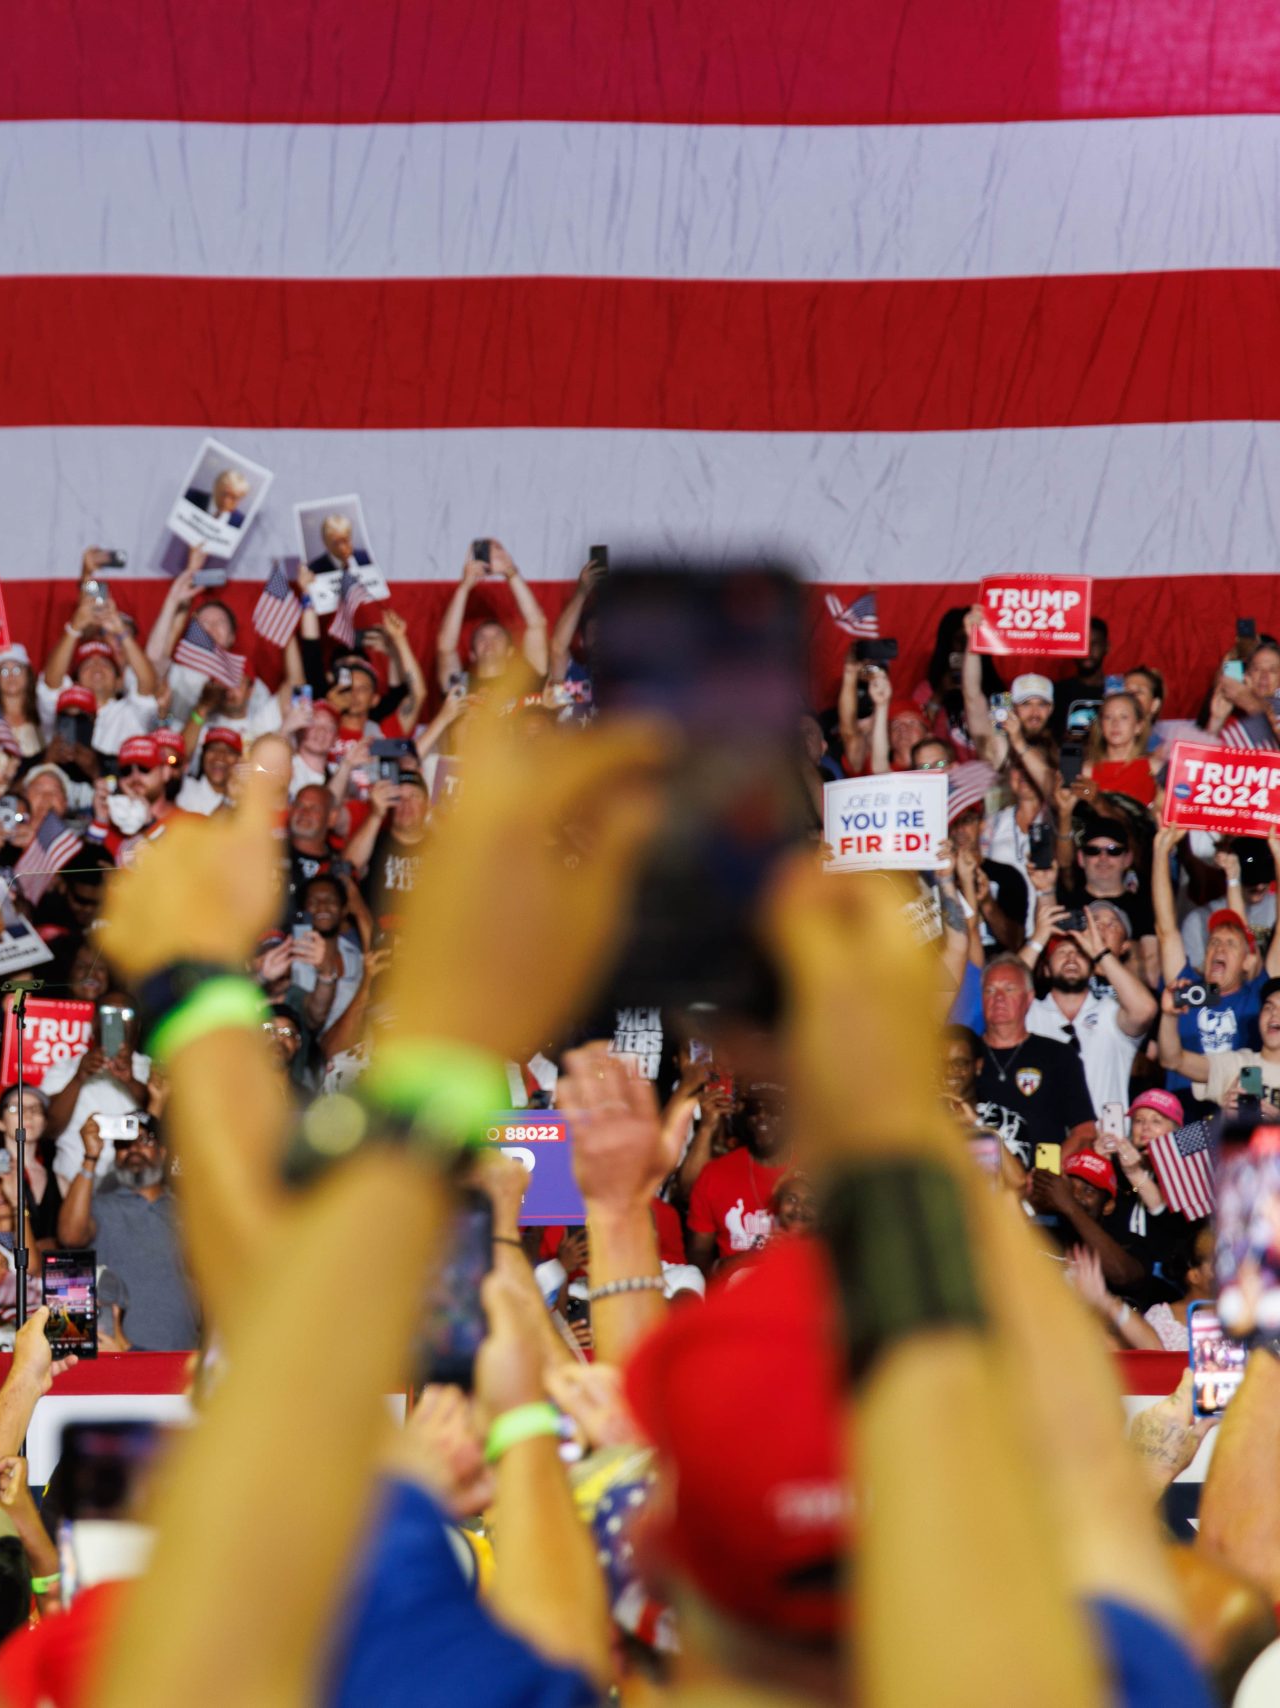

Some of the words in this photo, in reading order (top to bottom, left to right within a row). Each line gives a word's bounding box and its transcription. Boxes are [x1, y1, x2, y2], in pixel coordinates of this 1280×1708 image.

[987, 588, 1081, 611] TRUMP
[997, 607, 1066, 630] 2024
[1183, 759, 1280, 790] TRUMP
[874, 790, 922, 808] BIEN
[1193, 783, 1270, 810] 2024
[841, 810, 925, 832] YOURE
[23, 1016, 93, 1044] TRU
[31, 1041, 89, 1065] 202
[505, 1126, 559, 1141] 88022
